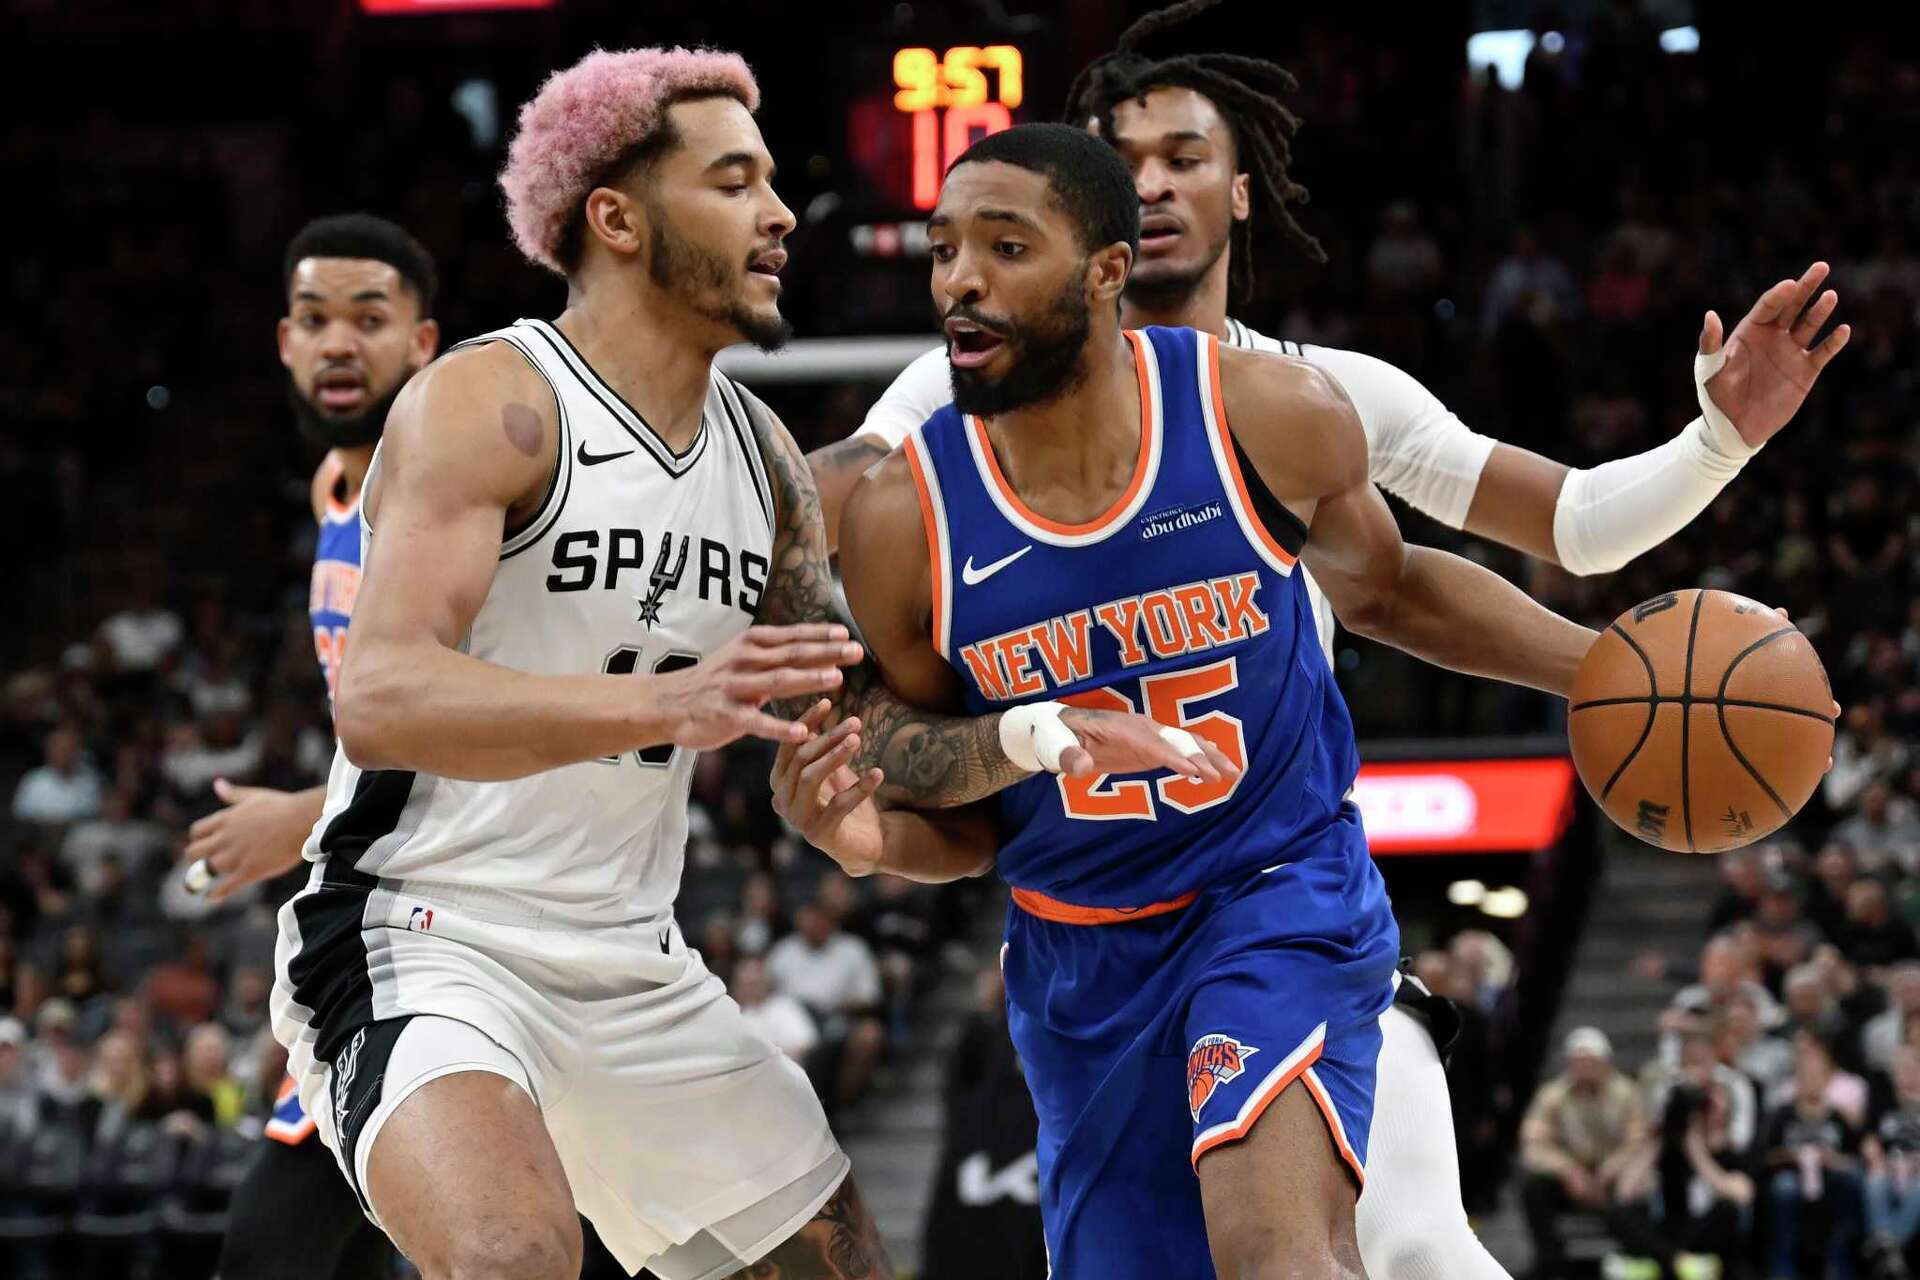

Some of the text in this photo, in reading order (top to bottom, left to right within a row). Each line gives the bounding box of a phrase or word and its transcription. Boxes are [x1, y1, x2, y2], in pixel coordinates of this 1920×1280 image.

[894, 45, 1023, 112] 9:57
[1142, 502, 1222, 539] abu dhabi
[546, 528, 768, 632] SPURS
[958, 570, 1270, 700] NEW YORK
